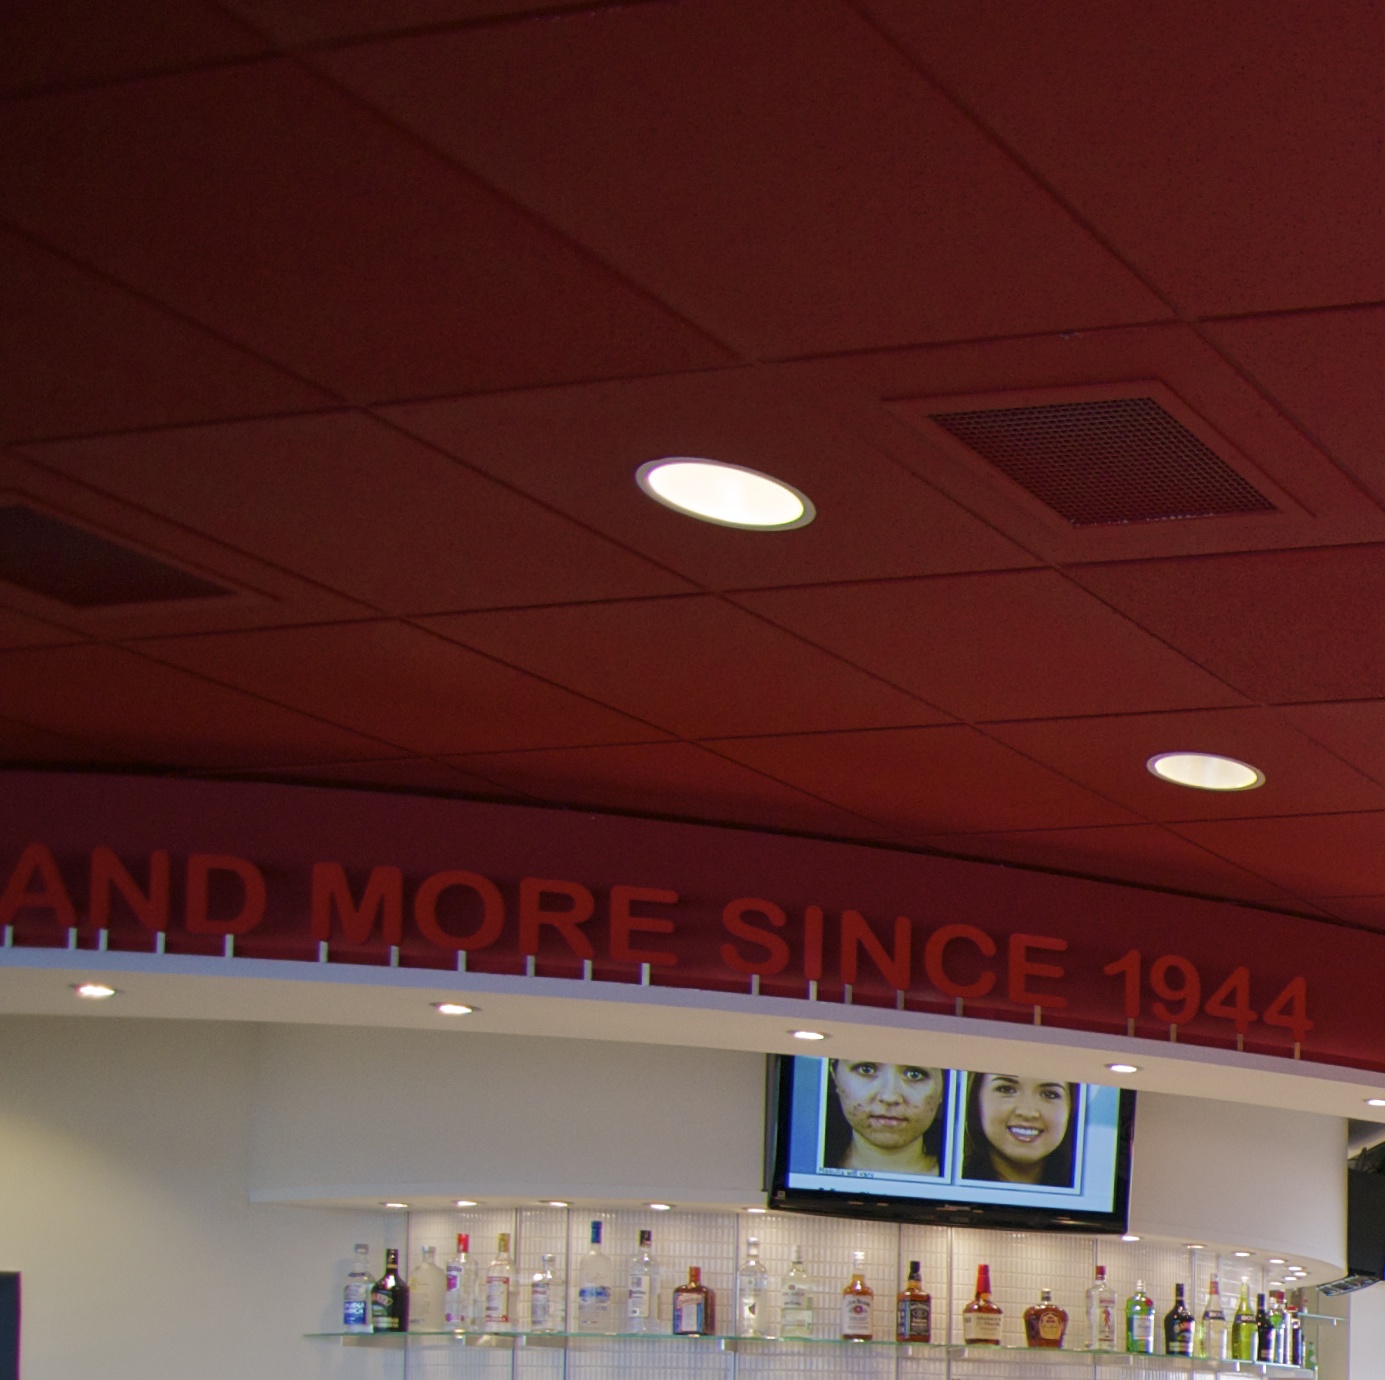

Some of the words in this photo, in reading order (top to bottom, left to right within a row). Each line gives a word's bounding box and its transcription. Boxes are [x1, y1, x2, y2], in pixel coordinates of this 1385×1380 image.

[3, 842, 266, 935] AND
[310, 861, 680, 966] MORE
[720, 898, 1069, 1008] SINCE
[1103, 949, 1314, 1042] 1944
